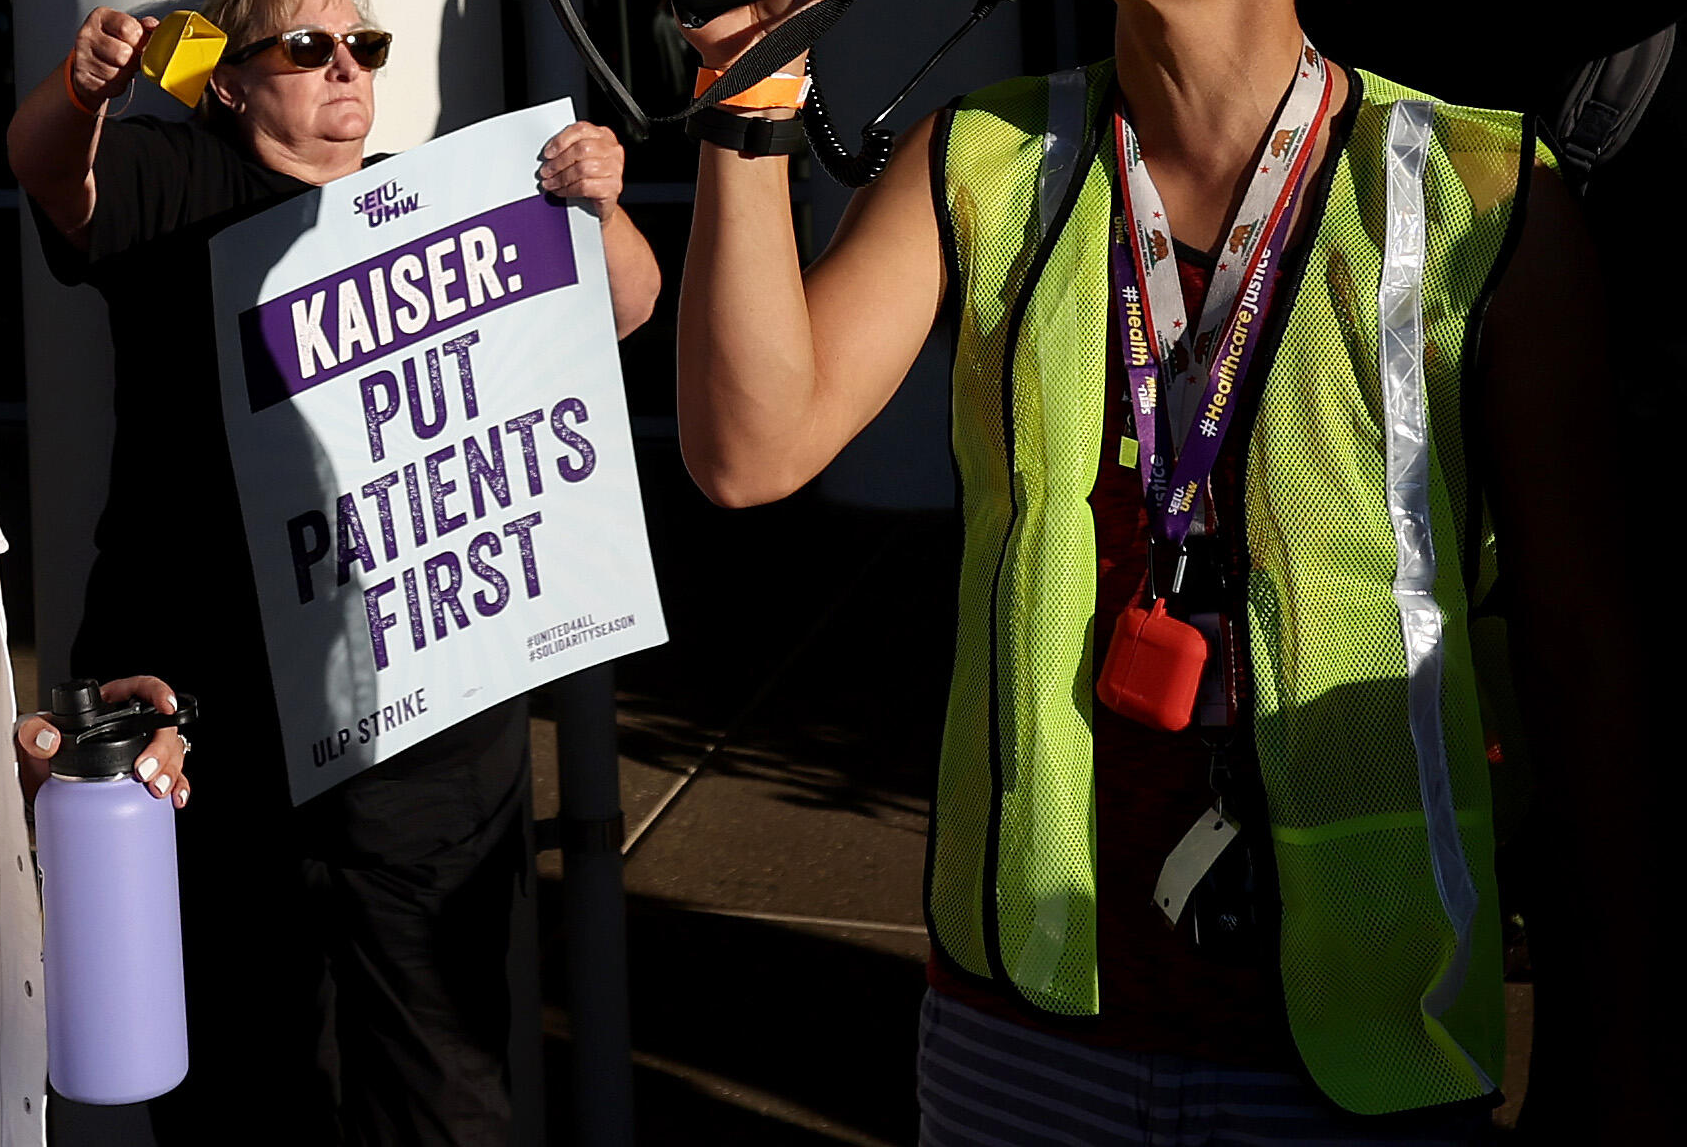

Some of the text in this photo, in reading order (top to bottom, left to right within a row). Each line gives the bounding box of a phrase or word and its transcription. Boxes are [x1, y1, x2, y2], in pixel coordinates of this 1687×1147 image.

[353, 181, 405, 216] SEIU-
[368, 193, 422, 229] UHW
[289, 224, 523, 380] KAISER:
[359, 330, 482, 463] PUT
[287, 397, 597, 605] PATIENTS
[363, 511, 543, 673] FIRST
[526, 614, 596, 650] #UNITED4ALL
[529, 614, 636, 663] #SOLIDARITYSEASON
[313, 688, 429, 768] ULP STRIKE
